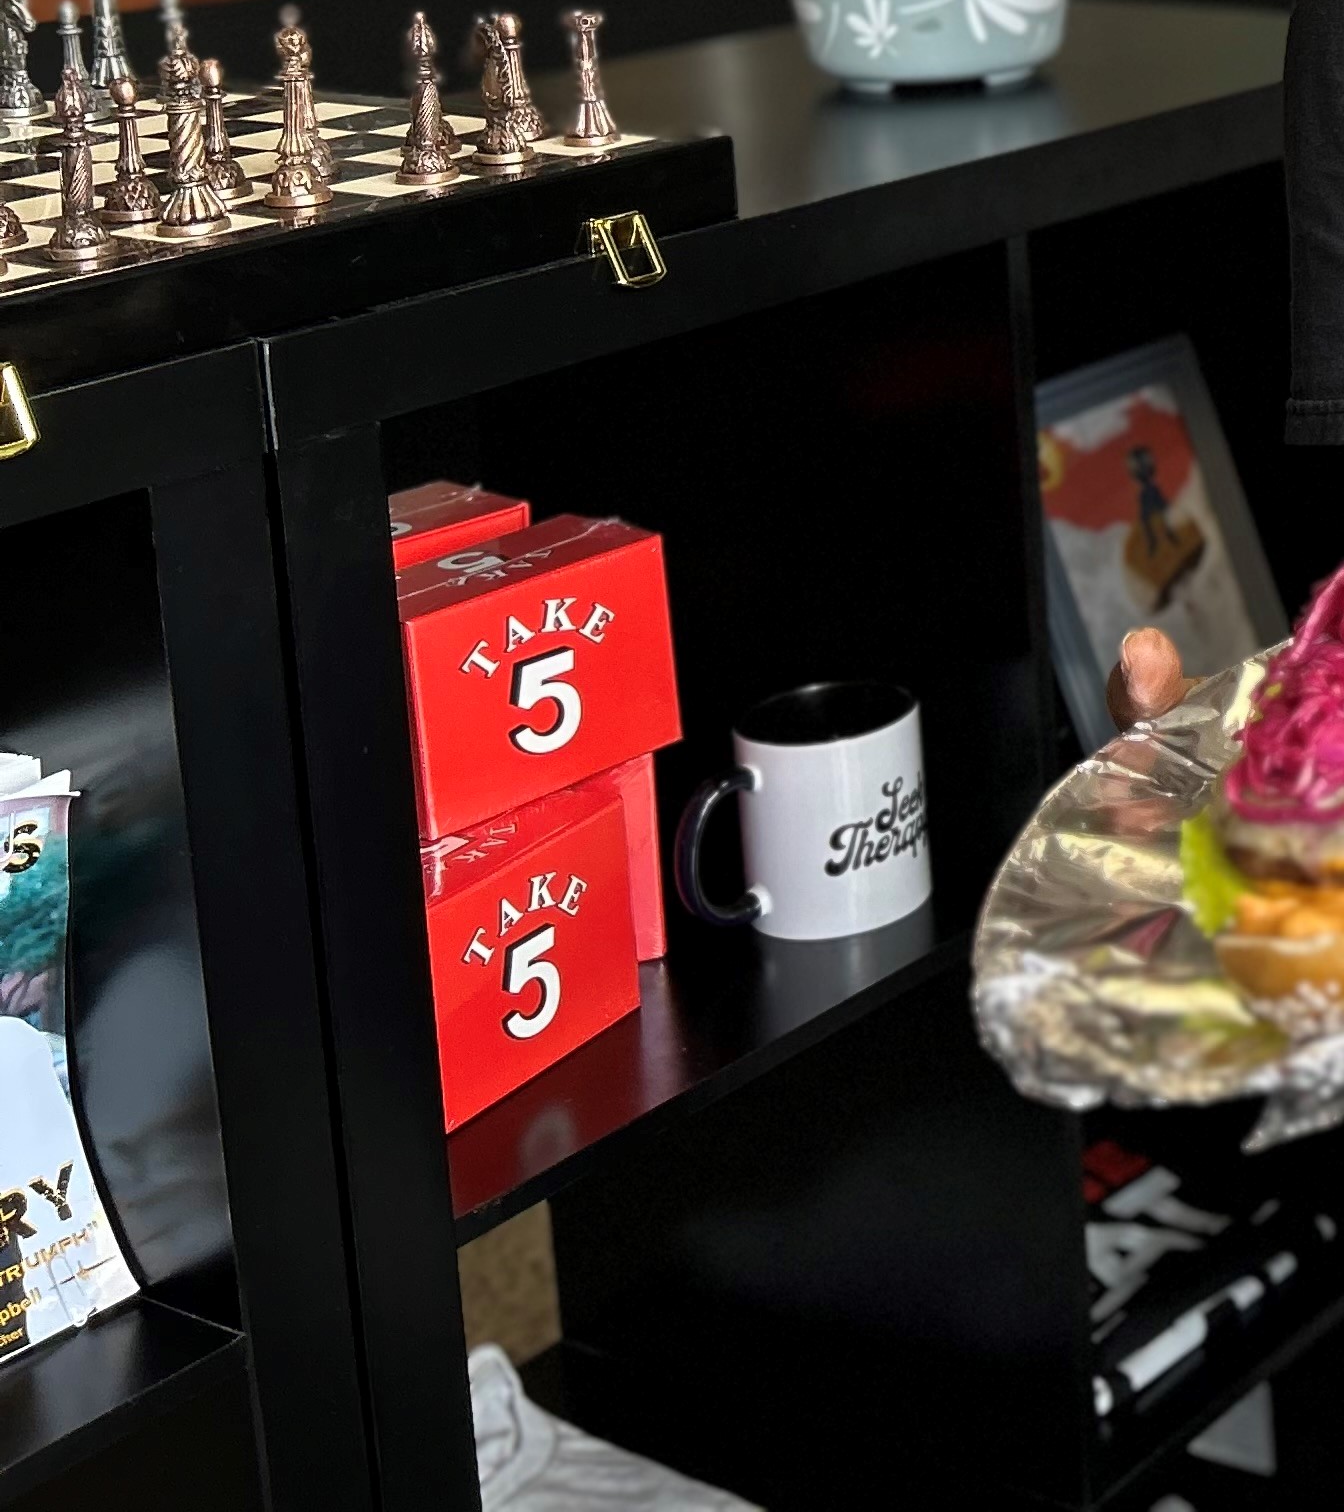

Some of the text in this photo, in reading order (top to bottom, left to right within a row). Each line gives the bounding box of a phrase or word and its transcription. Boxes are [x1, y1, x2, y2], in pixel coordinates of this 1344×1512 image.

[458, 597, 616, 679] TAKE
[508, 646, 583, 755] 5
[460, 871, 589, 967] TAKE
[501, 922, 562, 1041] 5
